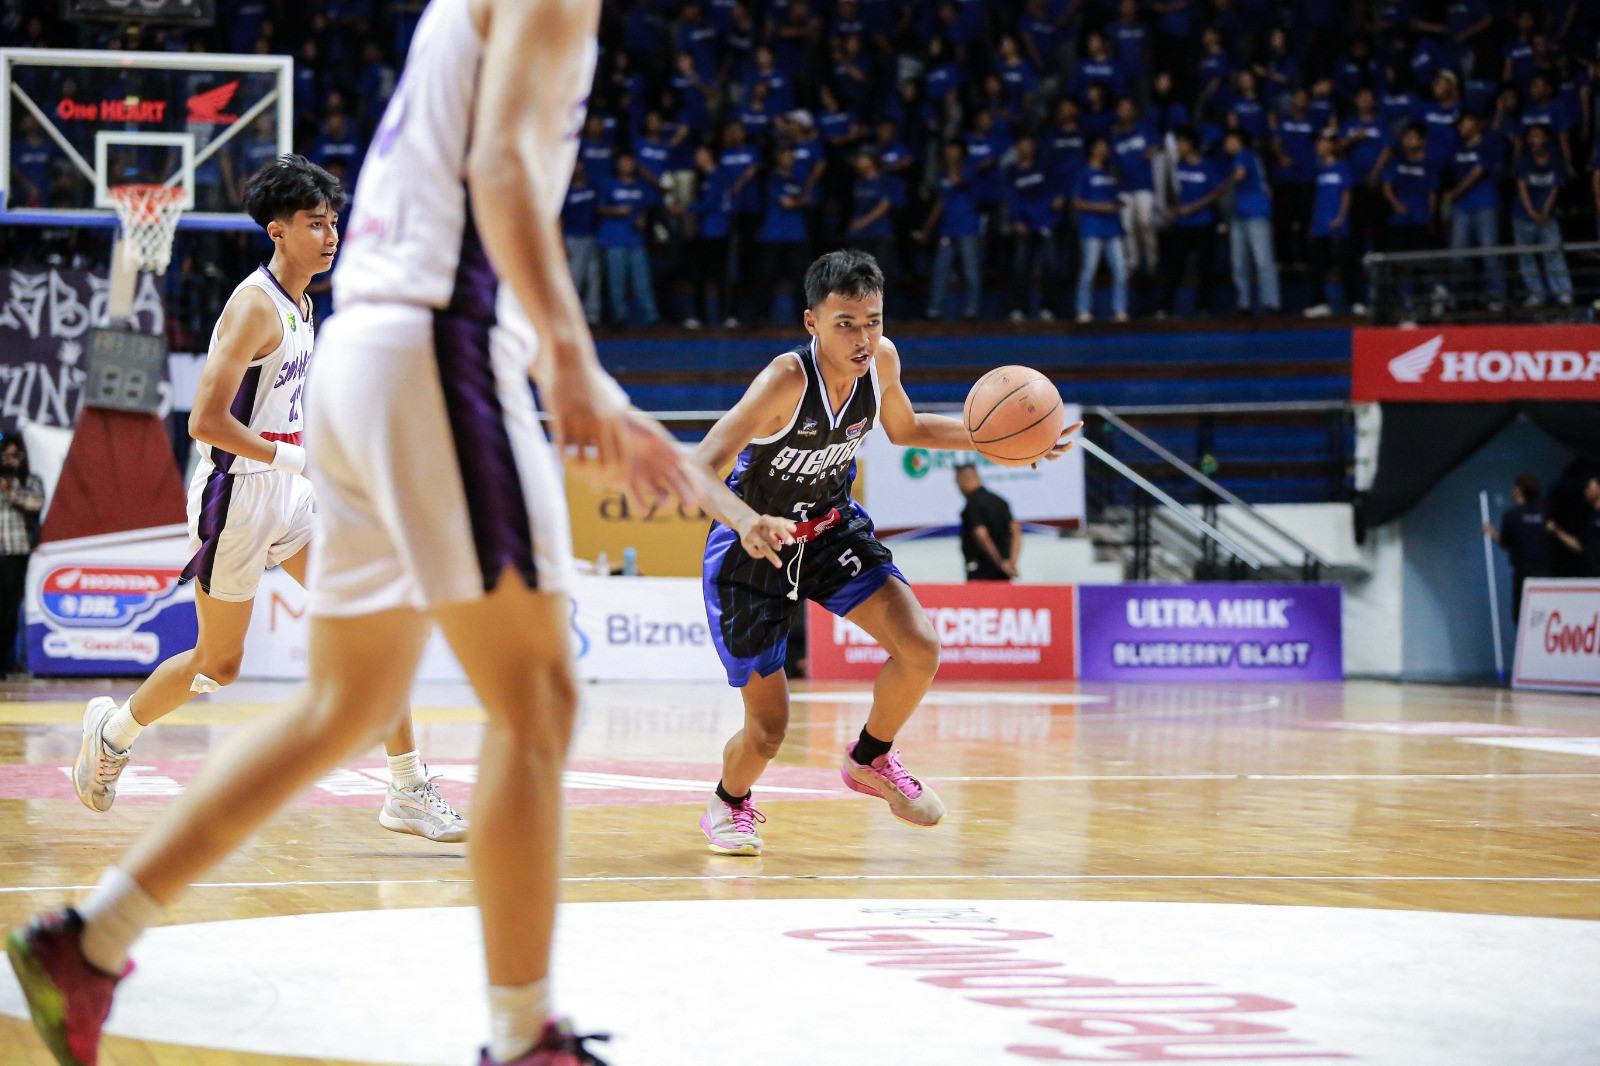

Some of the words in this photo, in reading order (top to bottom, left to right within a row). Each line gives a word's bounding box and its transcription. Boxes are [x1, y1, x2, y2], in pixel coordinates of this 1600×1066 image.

[57, 97, 98, 120] One
[100, 100, 167, 123] HEART
[768, 462, 850, 486] SURABAY
[837, 548, 862, 578] 5
[79, 573, 160, 591] HONDA
[1126, 598, 1215, 628] ULTRA
[1217, 598, 1290, 628] MILK
[1544, 609, 1599, 655] Good
[1113, 642, 1233, 666] BLUEBERRY
[1238, 642, 1311, 667] BLAST
